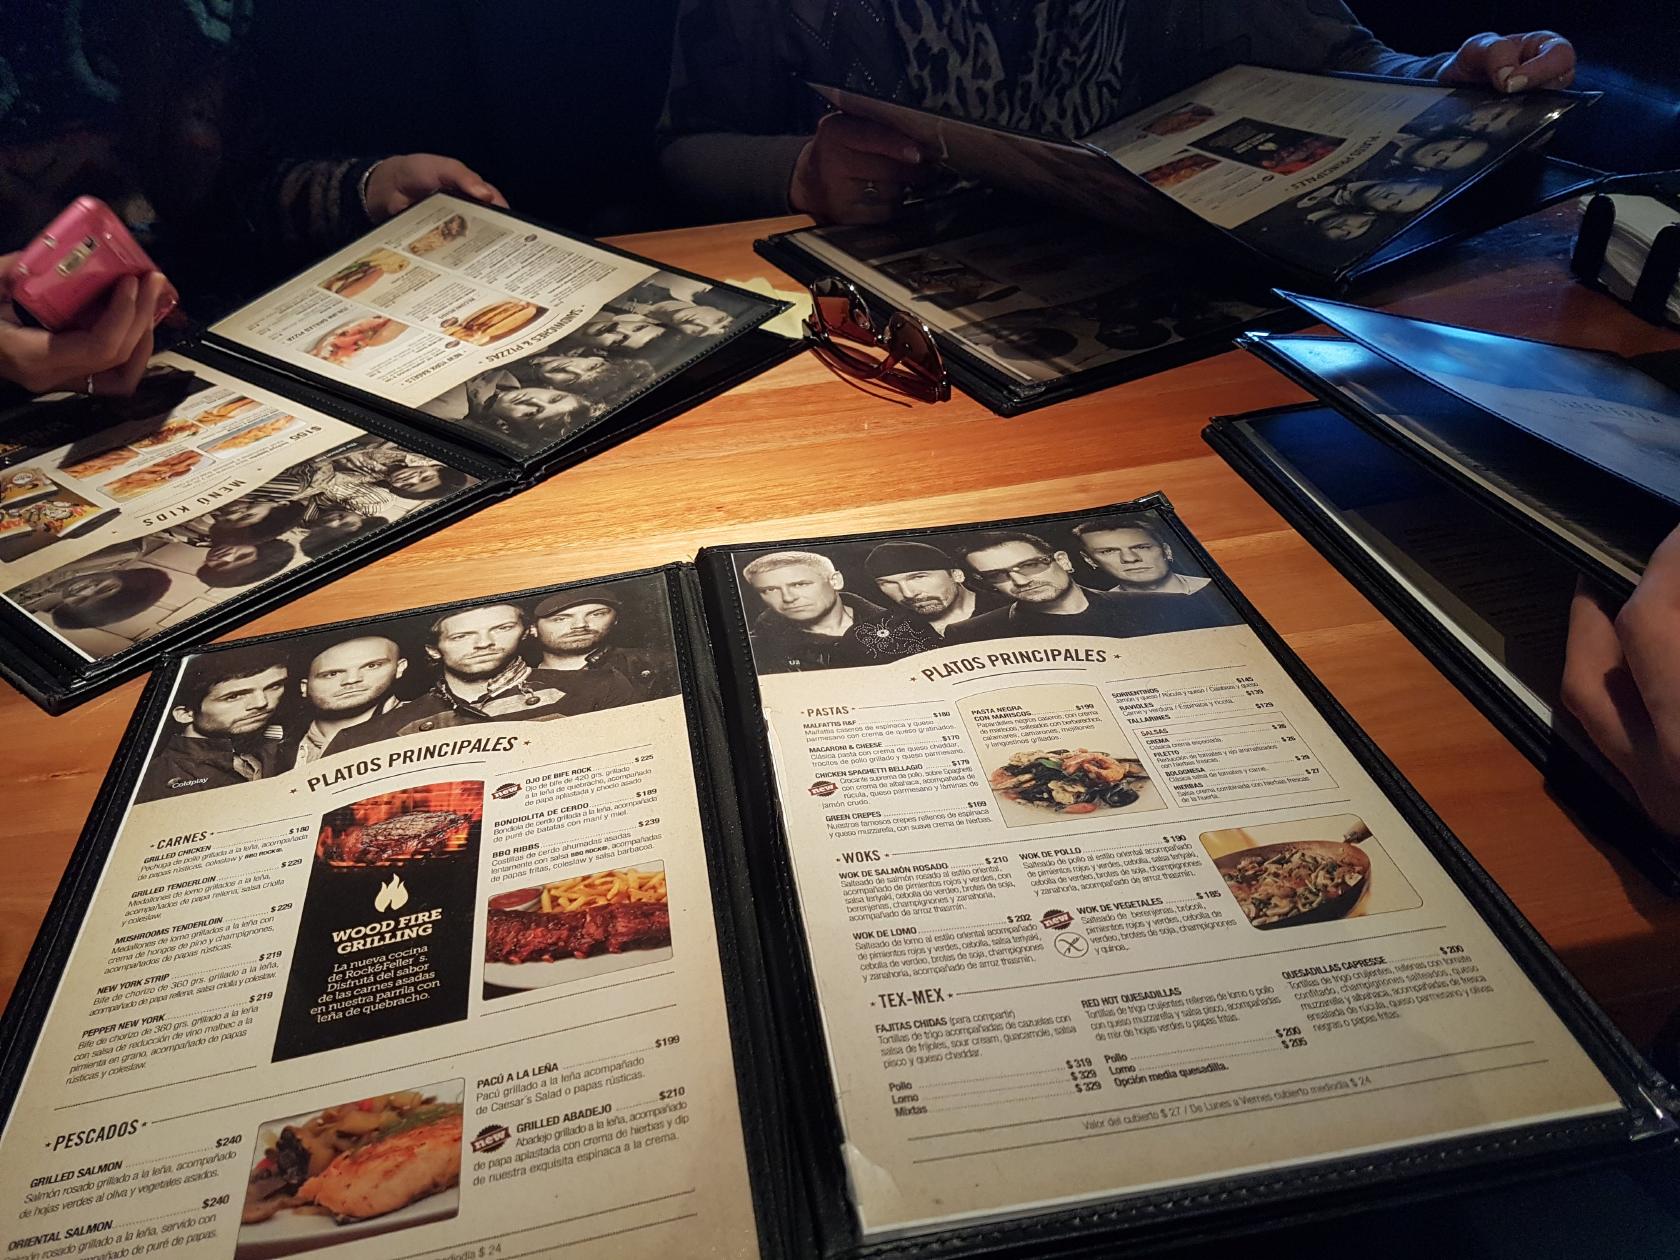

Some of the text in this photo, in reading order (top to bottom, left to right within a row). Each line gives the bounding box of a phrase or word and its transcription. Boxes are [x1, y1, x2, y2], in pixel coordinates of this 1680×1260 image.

[531, 309, 584, 342] SANDWICHES
[485, 344, 525, 362] PIZZAS
[143, 479, 247, 526] MENÚ KIDS
[921, 648, 1107, 682] PLATOS PRINCIPALES
[806, 705, 848, 717] PASTAS
[991, 710, 1031, 719] MARISCOS
[1119, 702, 1154, 710] RAVIOLES
[1126, 714, 1170, 723] TALLARINES
[1140, 728, 1168, 736] SALSAS
[808, 744, 847, 753] MACARONI
[855, 741, 882, 749] CHEESE
[1153, 749, 1179, 757] FILETTO
[306, 736, 519, 792] PLATOS PRINCIPALES
[814, 770, 847, 778] CHICKEN
[847, 767, 887, 775] SPAGHETTI
[887, 763, 923, 772] BELLAGIO
[171, 777, 208, 788] Coldplay
[525, 776, 540, 784] OJO
[553, 770, 569, 778] BIFE
[571, 766, 591, 775] ROCK
[494, 802, 588, 827] BONDIOLITA DE CERDO
[825, 813, 850, 821] GREEN
[851, 810, 881, 819] CREPES
[156, 830, 207, 849] CARNES
[492, 842, 539, 858] BBQ RIBBS
[143, 844, 211, 863] GRILLED CHICKEN
[841, 849, 880, 863] WOKS
[1018, 851, 1040, 860] WOK
[1053, 847, 1081, 856] POLLO
[838, 862, 948, 879] WOK DE SALMÓN ROSADO
[131, 875, 216, 898] GRILLED TENDERLOIN
[1075, 897, 1163, 914] WOK DE VEGETALES
[114, 916, 223, 944] MUSHROOMS TENDERLOIN
[331, 908, 442, 942] WOOD FIRE
[852, 926, 917, 940] WOK DE LOMO
[337, 923, 432, 954] GRILLING
[333, 945, 427, 972] La nueva cocina
[1281, 956, 1387, 979] QUESADILLAS CAPRESSE
[96, 973, 169, 994] NEW YORK STRIP
[317, 971, 435, 1003] de las carnes asadas
[327, 963, 429, 992] Disfrutá del sabor
[310, 1005, 325, 1014] en
[327, 995, 373, 1010] nuestra
[416, 980, 440, 990] con
[317, 1011, 342, 1023] leña
[362, 992, 430, 1014] quebracho.
[878, 987, 944, 1008] TEX-MEX
[1080, 987, 1181, 1008] RED HOT QUESADILLAS
[81, 1013, 165, 1038] PEPPER NEW YORK
[476, 1073, 503, 1088] PACÚ
[516, 1069, 529, 1080] LA
[532, 1062, 558, 1076] LEÑA
[654, 1034, 679, 1048] $199
[1103, 1052, 1127, 1063] Pollo
[476, 1088, 500, 1102] Pacú
[502, 1081, 538, 1098] grillado
[560, 1071, 581, 1083] leña
[583, 1056, 644, 1078] acompañado
[1108, 1065, 1136, 1075] Lomo
[475, 1105, 487, 1115] de
[535, 1087, 561, 1102] Salad
[573, 1080, 602, 1094] papas
[605, 1070, 645, 1085] rústicas.
[888, 1081, 912, 1092] Pollo
[891, 1093, 919, 1104] Lomo
[516, 1086, 684, 1133] GRILLED ABADEJO $210
[893, 1105, 927, 1116] Mixtas
[52, 1118, 138, 1151] PESCADOS
[29, 1134, 242, 1188] GRILLED SALMON $240
[7, 1194, 229, 1251] ORIENTAL SALMON $240
